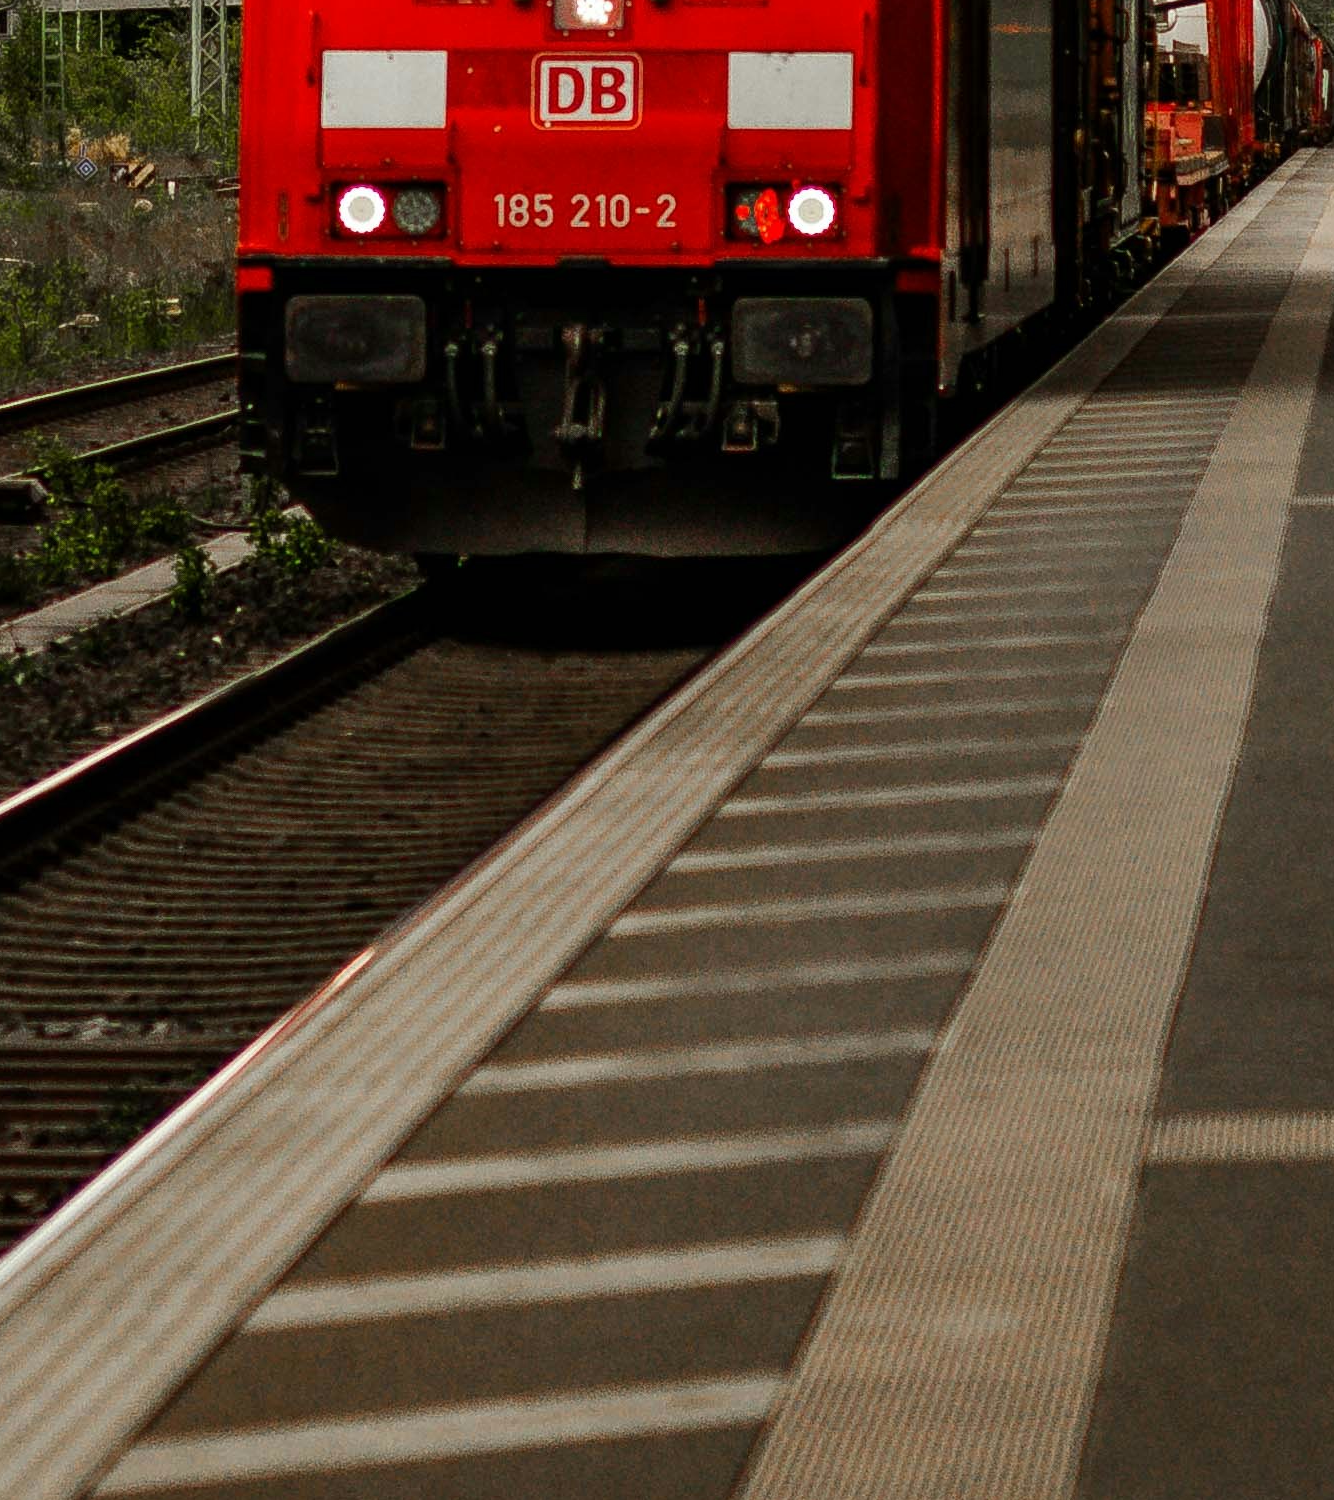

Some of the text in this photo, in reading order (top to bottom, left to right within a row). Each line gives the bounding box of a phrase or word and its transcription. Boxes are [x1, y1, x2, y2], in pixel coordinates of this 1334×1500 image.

[548, 66, 627, 114] DB
[494, 193, 677, 228] 185 210-2
